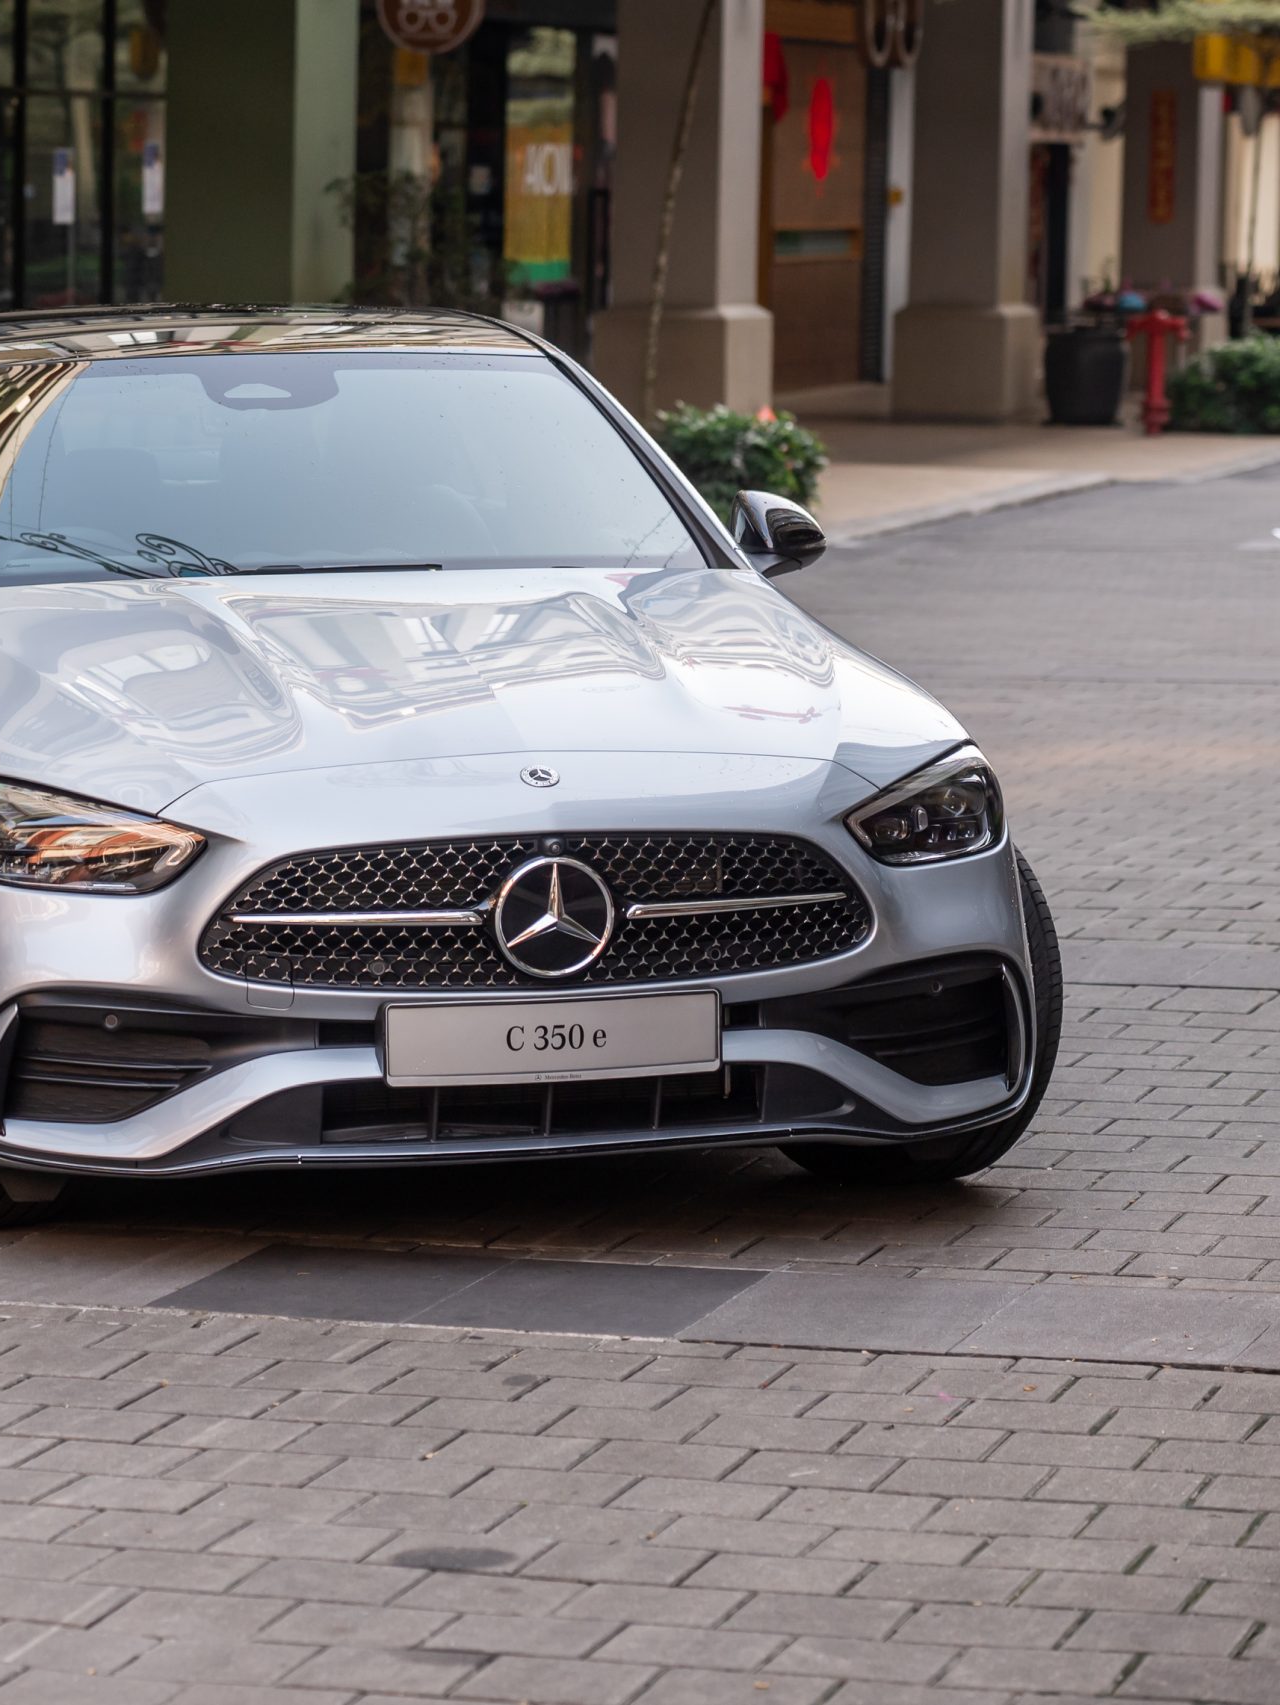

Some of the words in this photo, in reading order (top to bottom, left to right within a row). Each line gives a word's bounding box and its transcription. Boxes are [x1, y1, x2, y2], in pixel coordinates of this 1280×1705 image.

[506, 1025, 525, 1052] C
[533, 1023, 585, 1051] 350
[592, 1028, 607, 1048] e
